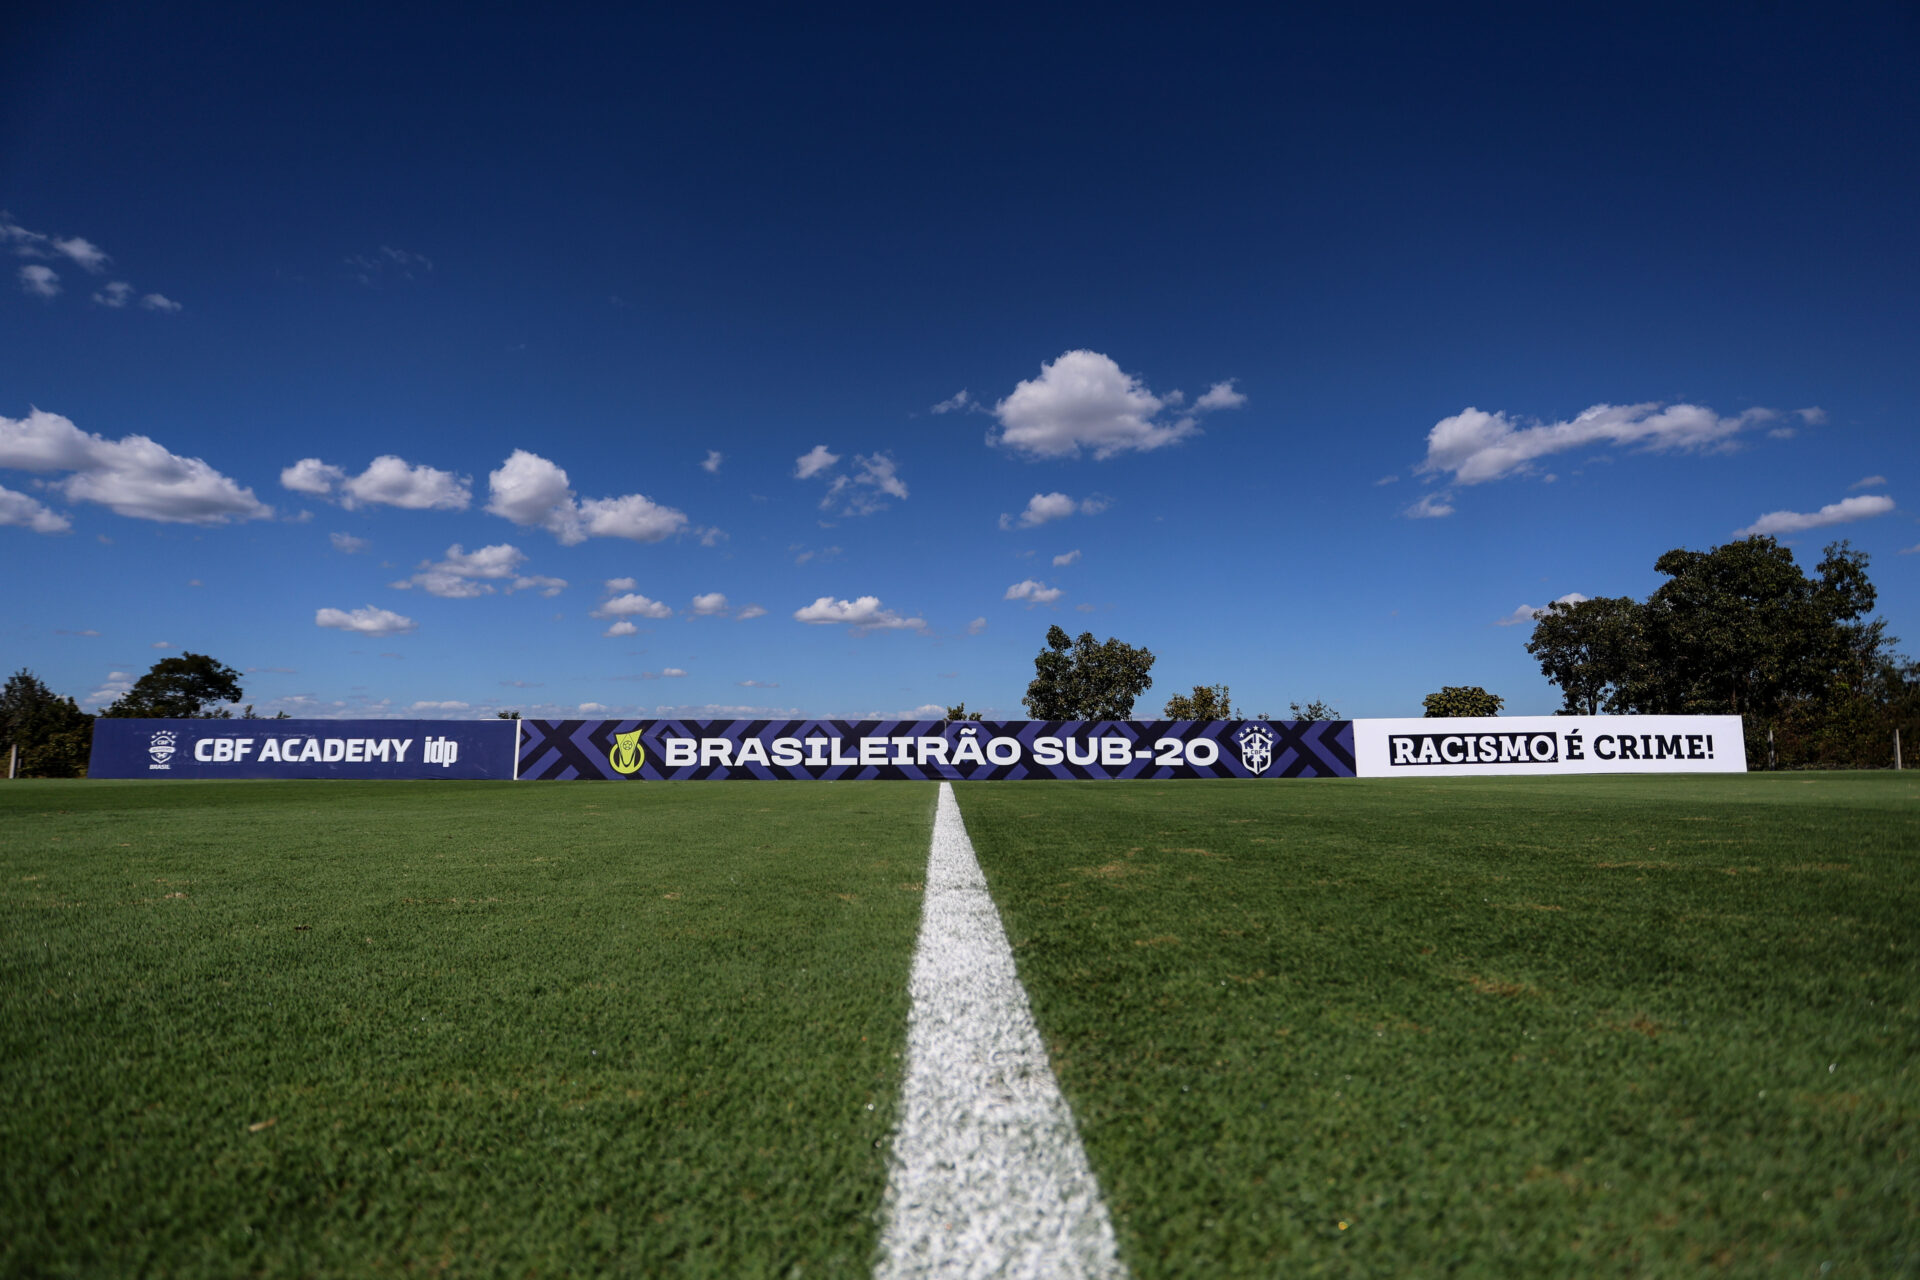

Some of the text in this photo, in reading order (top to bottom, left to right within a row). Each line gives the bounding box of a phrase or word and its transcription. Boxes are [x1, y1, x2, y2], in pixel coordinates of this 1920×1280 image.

[194, 738, 412, 763] CBF ACADEMY
[423, 736, 458, 768] idp
[665, 728, 1219, 767] BRASILEIRÃO SUB-20
[1394, 728, 1714, 764] RACISMO É CRIME!
